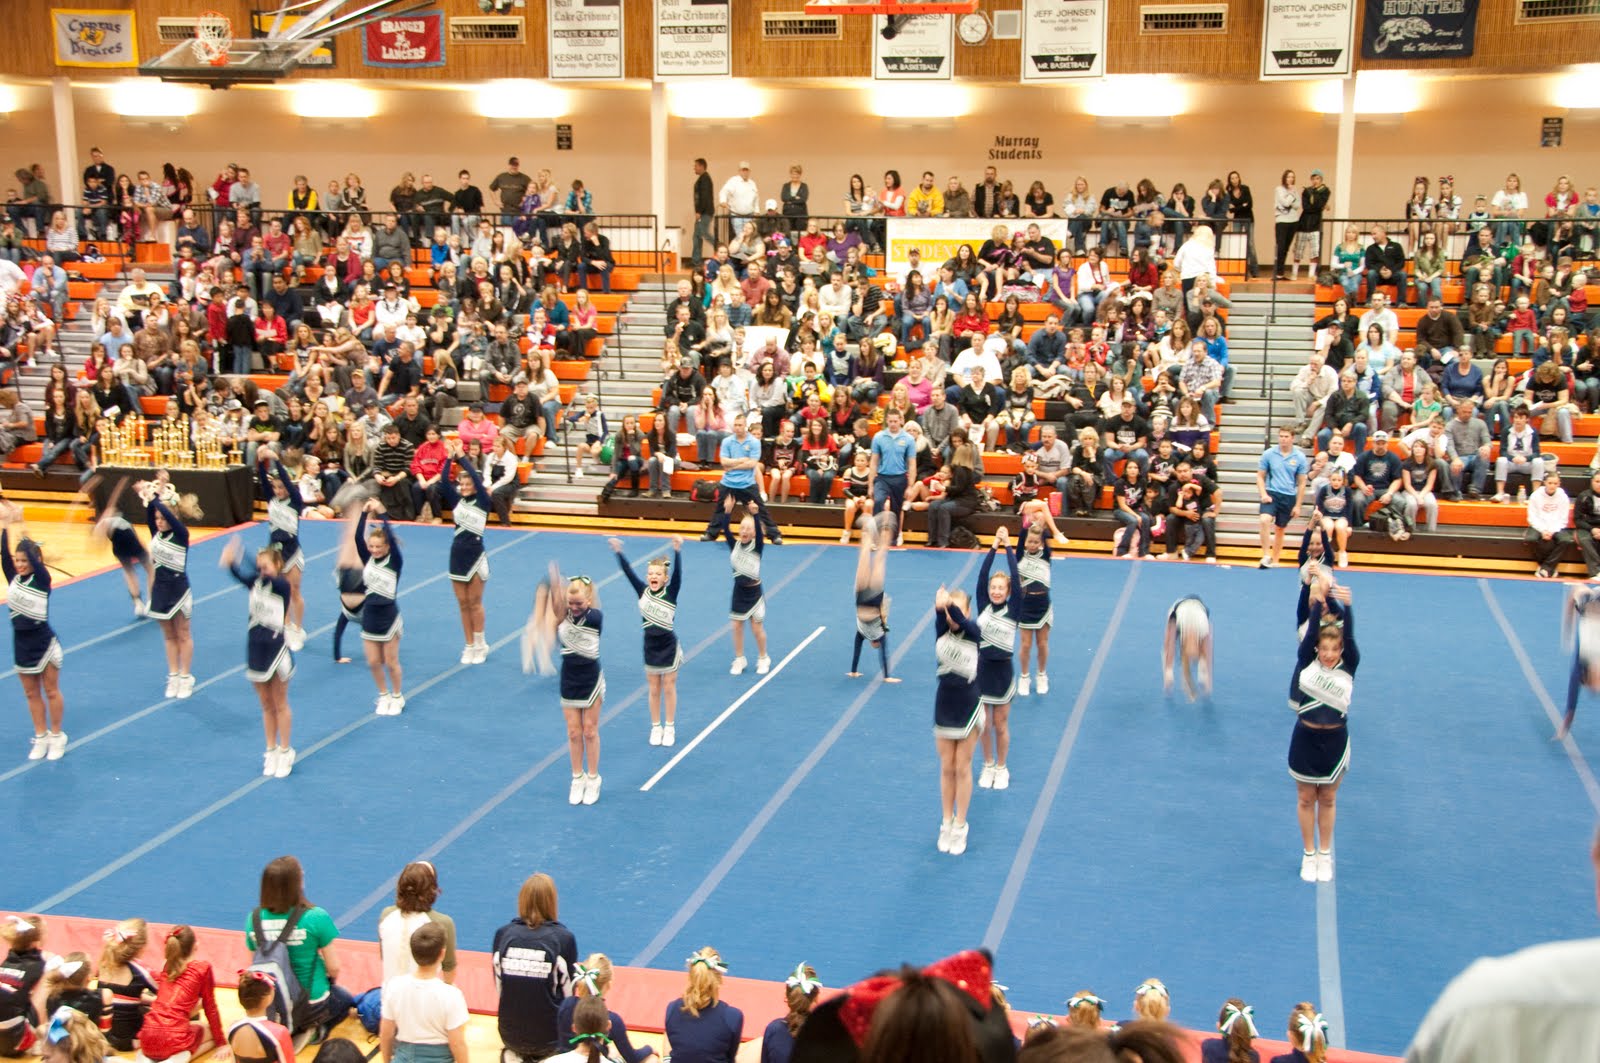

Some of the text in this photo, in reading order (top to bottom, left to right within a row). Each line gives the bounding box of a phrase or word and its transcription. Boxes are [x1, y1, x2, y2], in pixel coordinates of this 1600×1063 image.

[1273, 3, 1347, 13] BRITTON JOHNSEN
[1383, 0, 1464, 15] HUNTER
[1056, 9, 1096, 17] JOHNSEN
[381, 46, 426, 60] LANCERS
[555, 53, 618, 61] KESHIA CATTEN
[661, 50, 726, 59] MELINDA JOHNSEN
[1050, 61, 1090, 69] BASKETBALL
[1292, 57, 1335, 65] BASKETBALL
[900, 63, 938, 71] BASKETBALL
[994, 136, 1039, 148] Murray
[988, 148, 1042, 160] Students
[893, 243, 961, 259] STDEN
